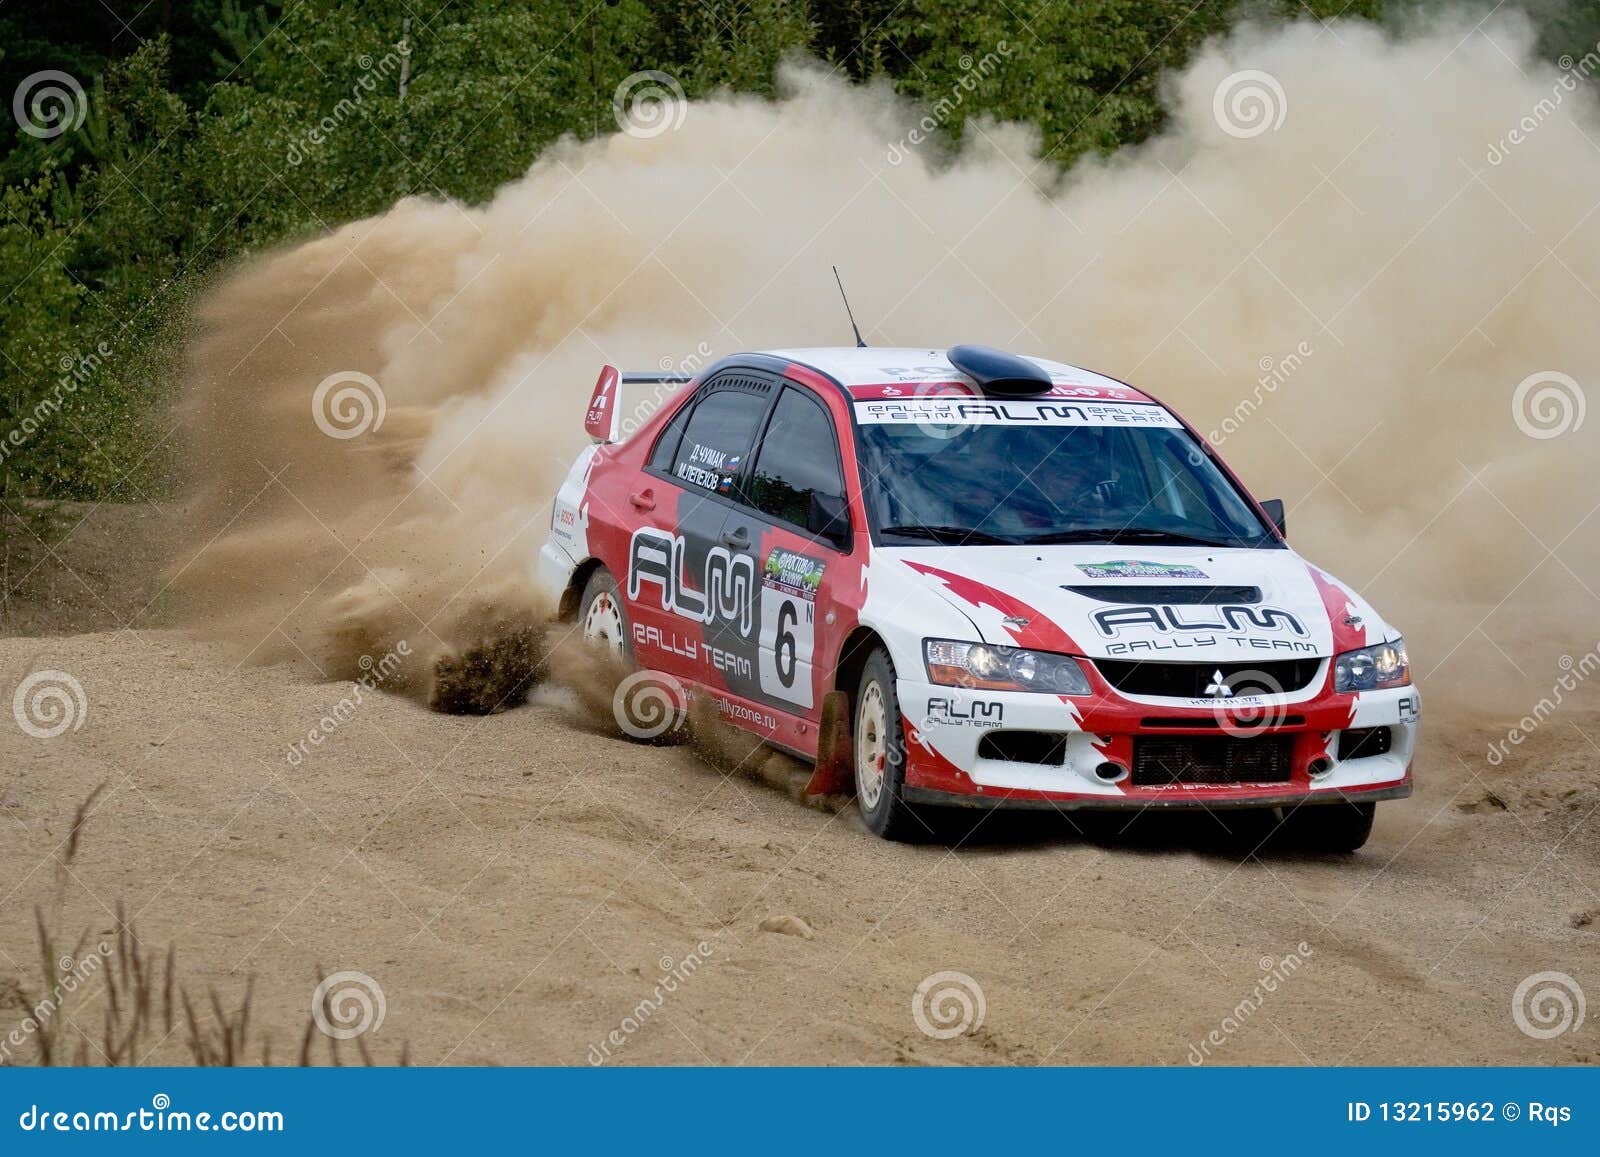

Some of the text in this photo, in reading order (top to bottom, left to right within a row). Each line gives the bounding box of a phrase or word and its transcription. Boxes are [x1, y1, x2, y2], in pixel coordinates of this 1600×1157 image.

[628, 526, 754, 638] ALM
[806, 602, 814, 625] N
[1092, 605, 1307, 637] ALM
[633, 623, 752, 681] RALLY TEAM
[774, 599, 798, 689] 6
[1106, 636, 1319, 656] RALLY TEAM
[927, 697, 1004, 721] ALM
[966, 719, 1003, 729] TEAM
